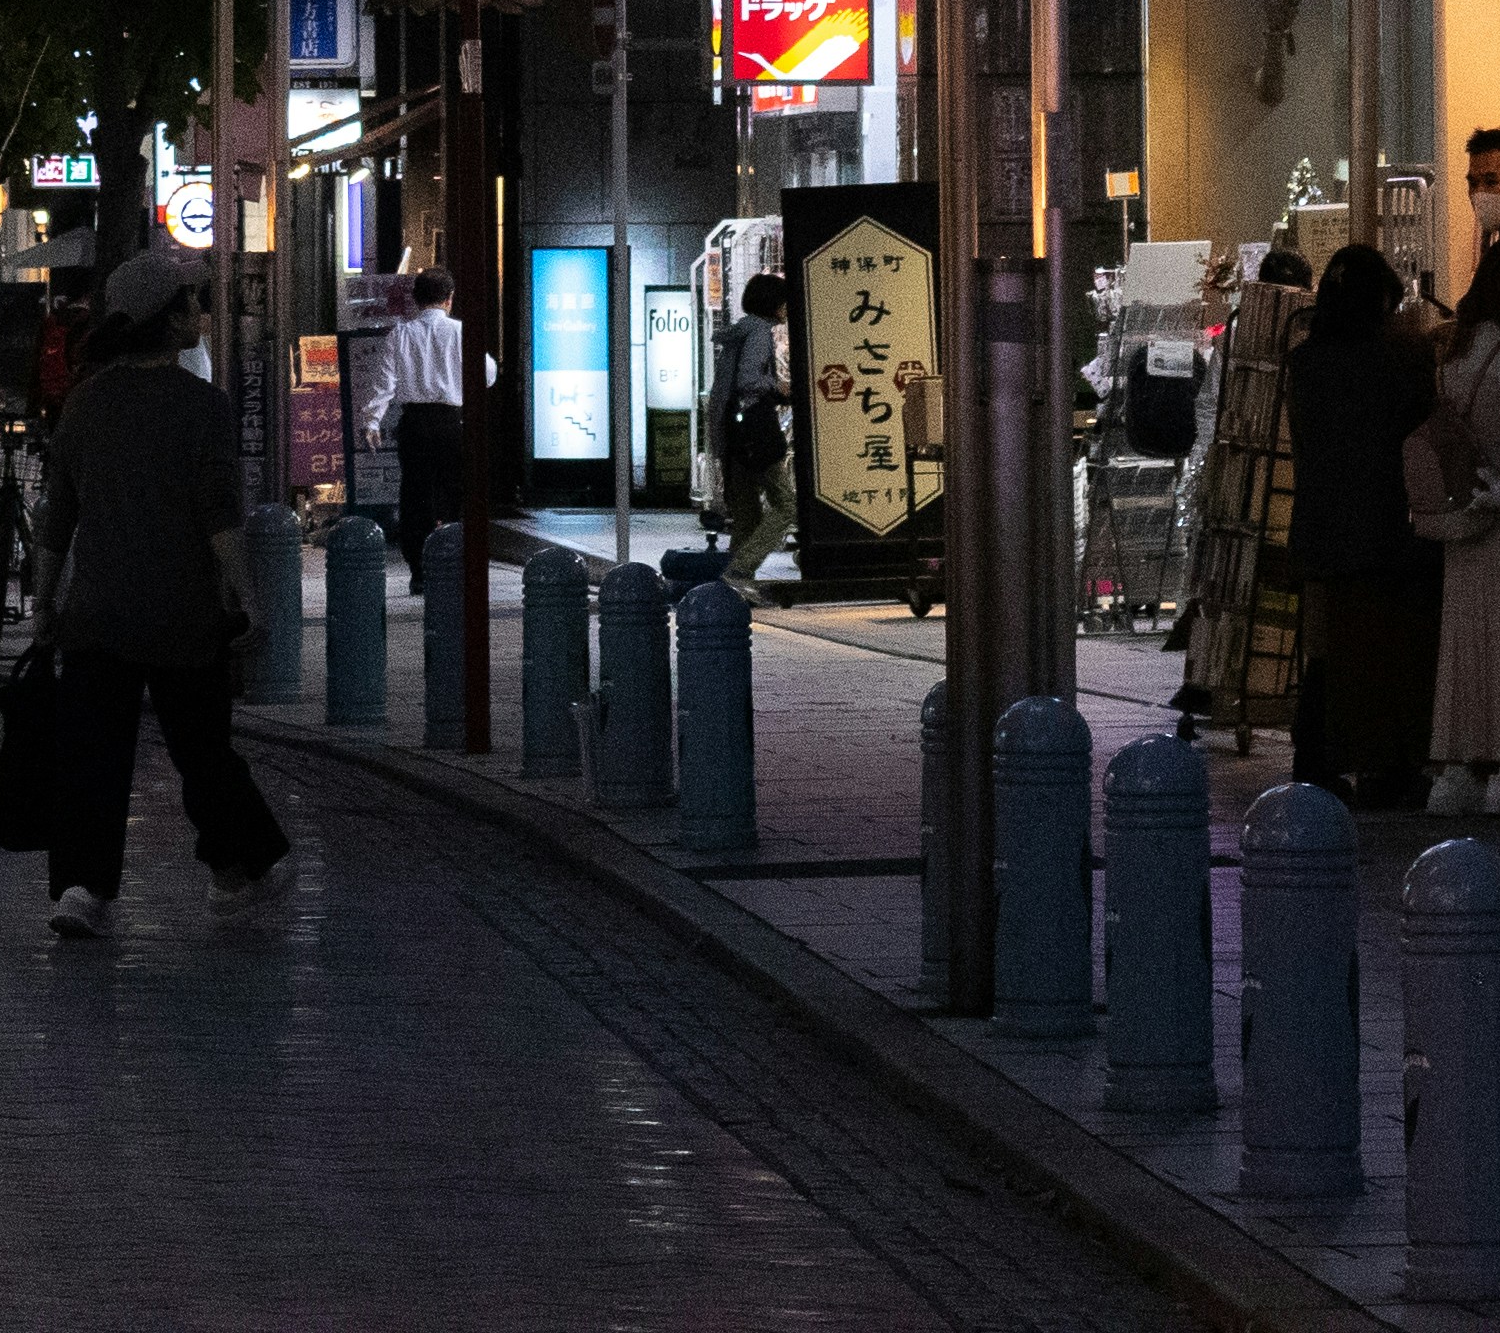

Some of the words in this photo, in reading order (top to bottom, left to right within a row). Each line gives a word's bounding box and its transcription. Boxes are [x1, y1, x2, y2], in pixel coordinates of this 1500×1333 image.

[830, 254, 905, 275] 神保町
[649, 308, 690, 341] folio
[241, 349, 266, 454] 犯カメラ作動中
[311, 453, 345, 473] 2F
